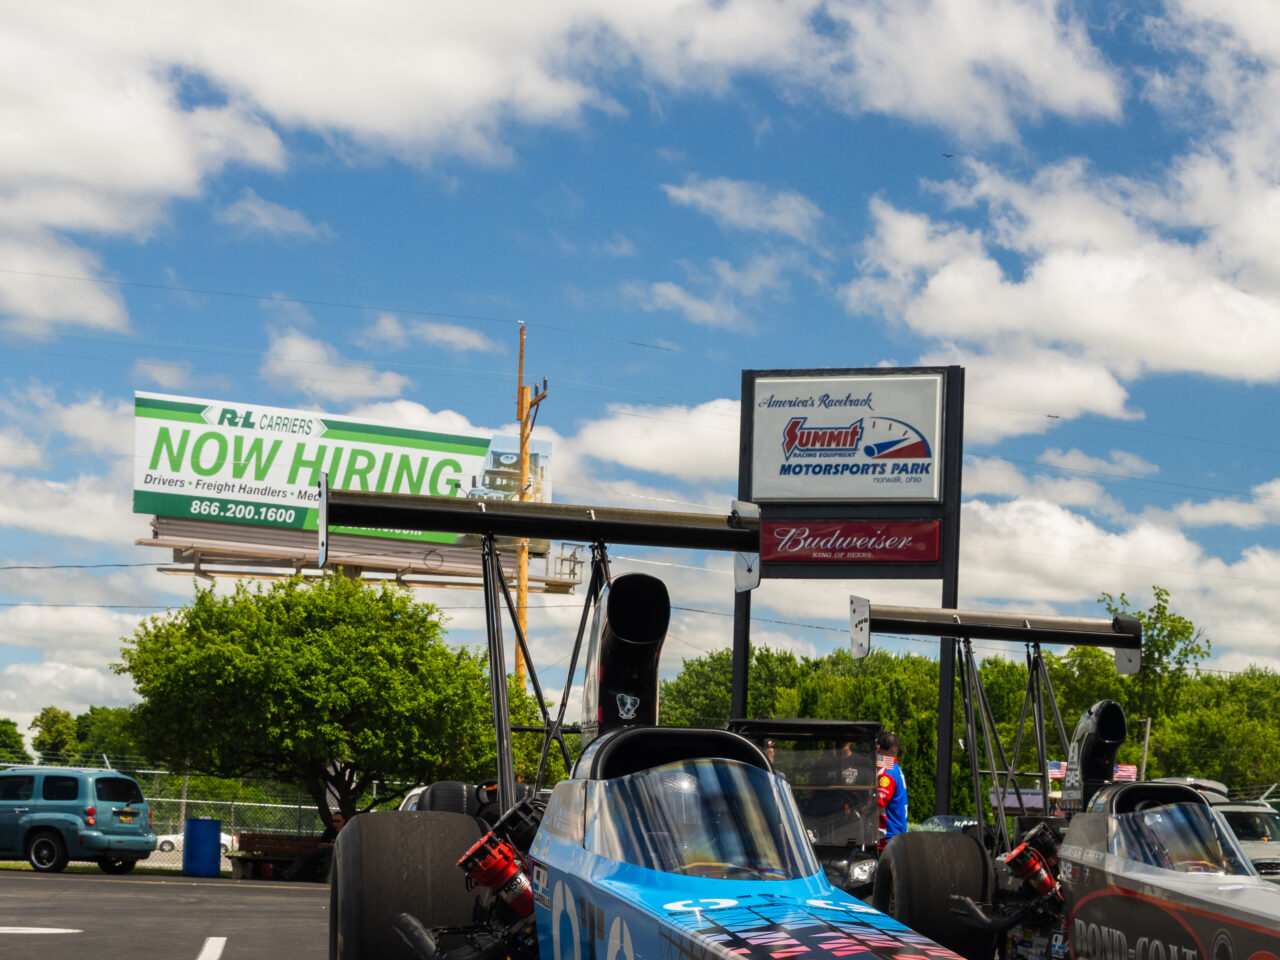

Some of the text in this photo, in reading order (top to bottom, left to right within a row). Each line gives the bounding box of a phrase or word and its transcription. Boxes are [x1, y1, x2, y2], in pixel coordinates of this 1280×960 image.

[758, 392, 876, 411] America's Racetrack
[259, 414, 313, 436] CARRIERS
[784, 418, 863, 459] SUMMIT
[148, 427, 463, 499] NOW HIRING
[779, 462, 932, 476] MOTORSPORTS PARK
[143, 474, 186, 488] Drivers
[195, 479, 235, 494] Freight
[238, 484, 288, 499] Handlers
[906, 476, 922, 484] ohio
[190, 500, 296, 524] 866.200.1600
[774, 527, 913, 552] Budweiser
[503, 876, 523, 895] MSD
